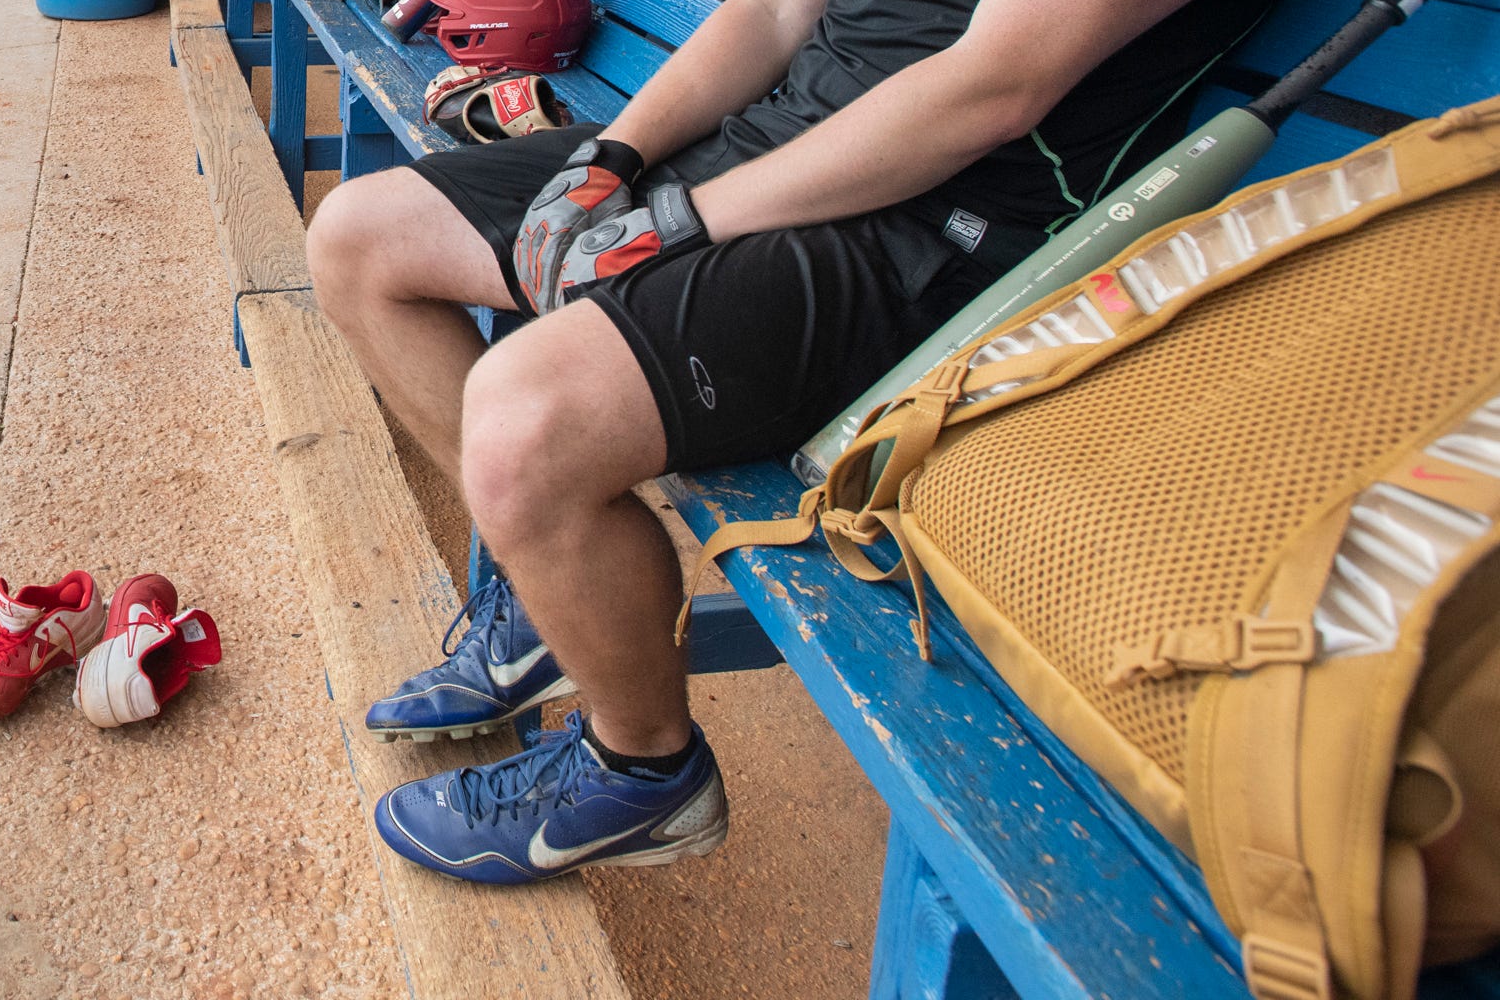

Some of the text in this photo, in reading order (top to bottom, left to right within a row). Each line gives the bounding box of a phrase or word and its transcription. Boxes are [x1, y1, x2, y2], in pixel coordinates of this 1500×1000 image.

[469, 21, 509, 30] RAWLINGS
[1140, 185, 1155, 198] 50
[950, 224, 976, 239] COMBAT
[951, 219, 981, 237] NIKE PRO
